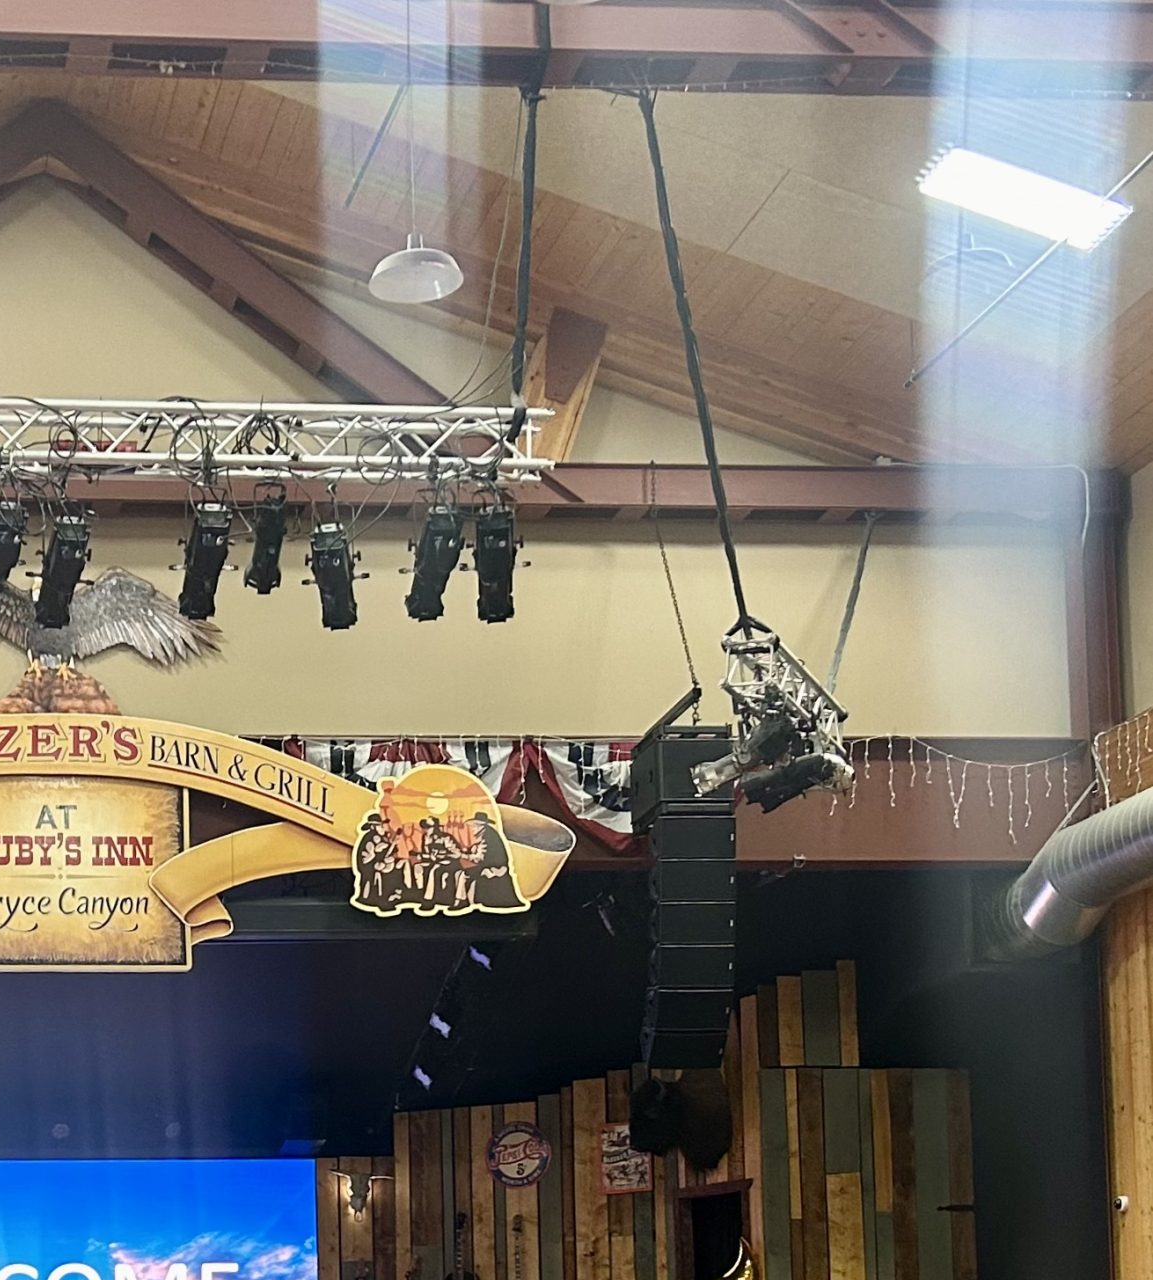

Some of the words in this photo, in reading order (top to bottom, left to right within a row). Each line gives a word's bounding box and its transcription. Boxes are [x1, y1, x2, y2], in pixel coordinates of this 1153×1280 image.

[150, 734, 219, 775] BARN
[227, 753, 248, 782] &
[254, 762, 336, 818] GRILL
[35, 804, 78, 830] AT
[91, 835, 154, 867] INN
[57, 886, 149, 933] Canyon
